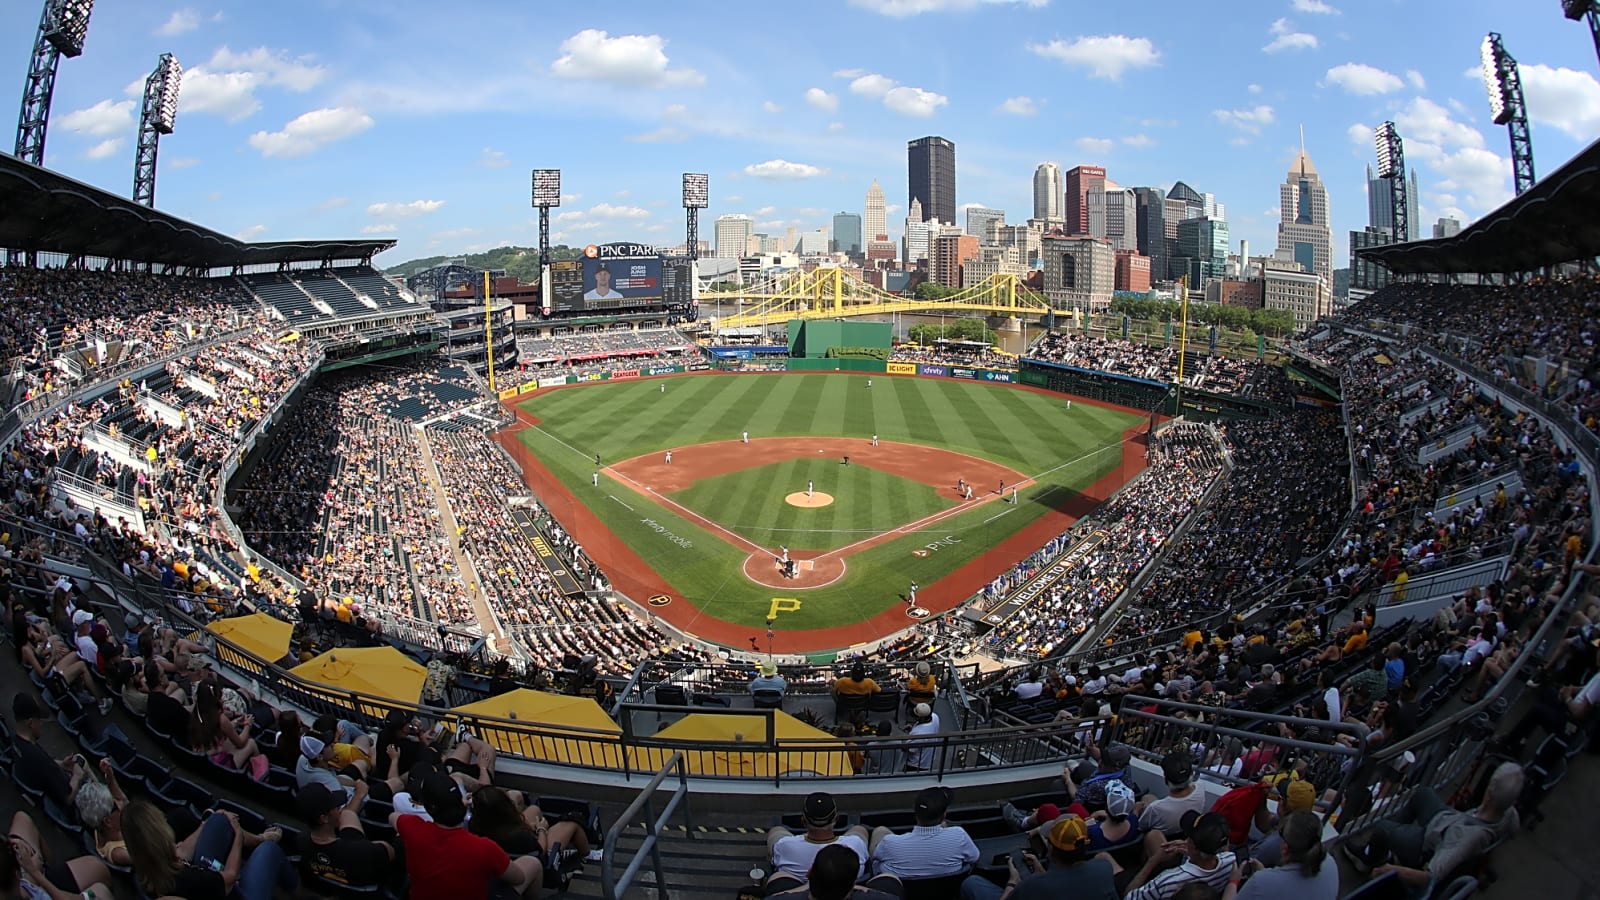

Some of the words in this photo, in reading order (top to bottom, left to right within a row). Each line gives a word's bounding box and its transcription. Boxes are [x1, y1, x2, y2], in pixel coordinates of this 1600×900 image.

[600, 246, 626, 256] PNC
[629, 245, 659, 256] PARK
[613, 370, 639, 379] SEATGEEK
[923, 365, 943, 375] xfinity
[925, 535, 962, 551] PNC
[1009, 574, 1055, 606] WELCOME
[1049, 565, 1065, 576] TO
[766, 597, 802, 619] P
